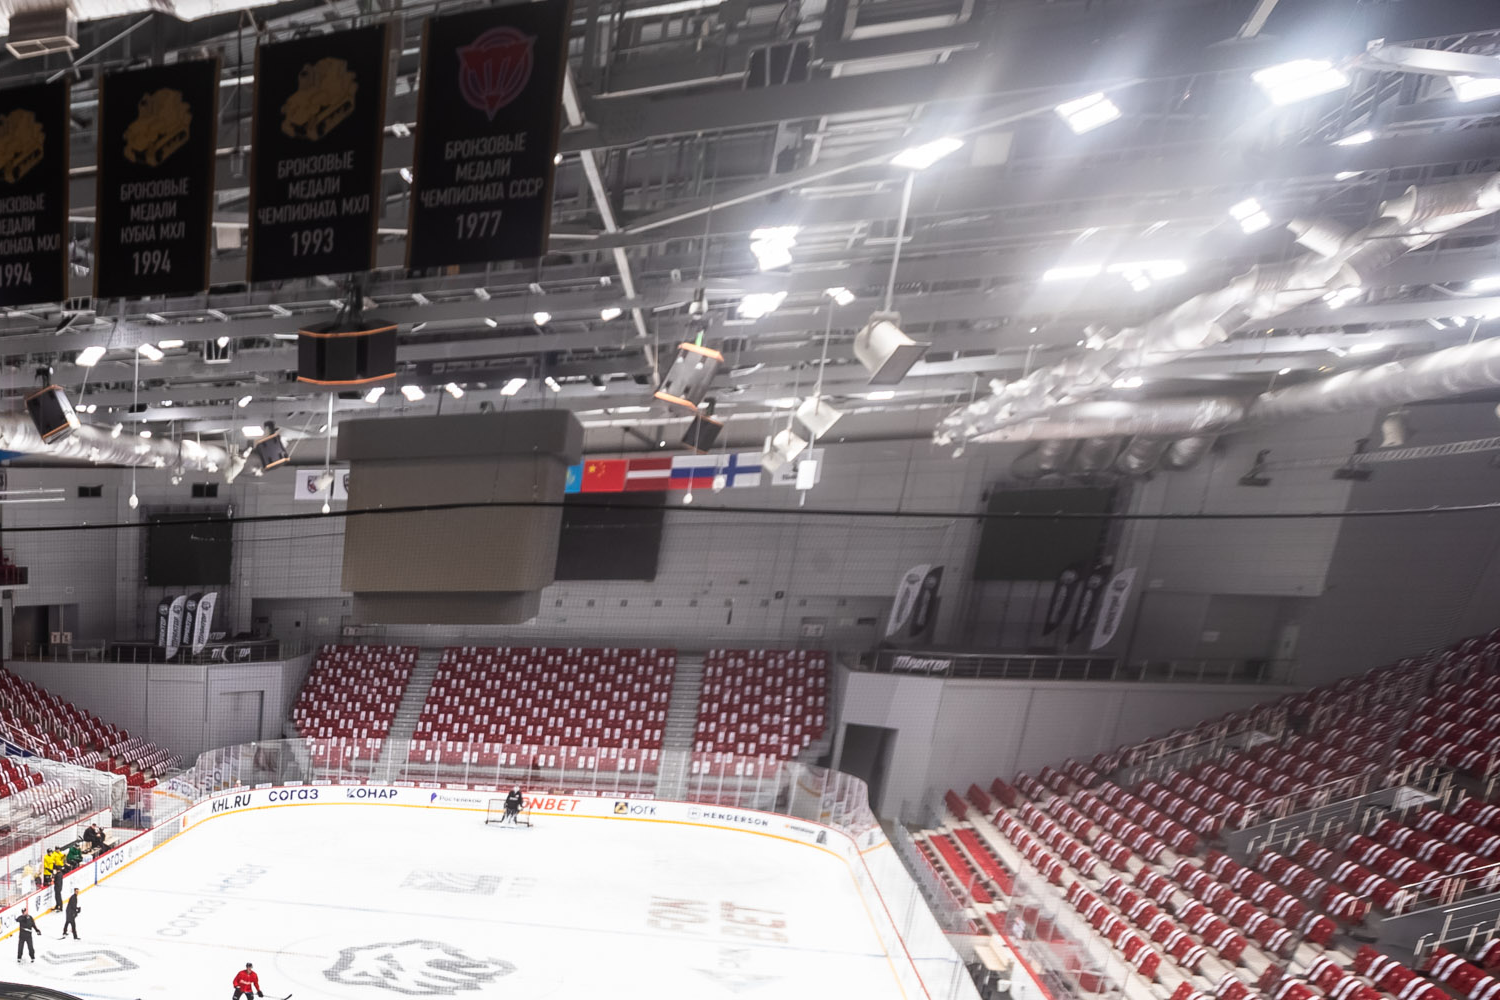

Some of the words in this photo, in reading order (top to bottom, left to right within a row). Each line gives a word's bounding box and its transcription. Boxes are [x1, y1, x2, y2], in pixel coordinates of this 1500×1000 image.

[444, 132, 527, 160] БРОНЗОВЫЕ
[277, 150, 355, 179] БРОНЗОВЫЕ
[455, 158, 511, 181] МЕДАЛИ
[120, 177, 189, 202] БРОНЗОВЫЕ
[288, 176, 340, 200] МЕДАЛИ
[420, 182, 505, 209] ЧЕМПИОНАТА
[508, 177, 544, 201] СССР
[130, 202, 177, 222] МЕДАЛИ
[258, 199, 337, 225] ЧЕМПИОНАТА
[341, 194, 370, 216] МХЛ
[121, 225, 157, 245] КУБКА
[160, 221, 185, 240] МХЛ
[455, 210, 503, 239] 1977
[37, 233, 61, 252] МХЛ
[290, 227, 334, 256] 1993
[132, 249, 171, 276] 1994
[212, 794, 251, 813] KHL.RU
[522, 797, 580, 812] ONBET
[630, 805, 657, 816] ЮГК
[703, 812, 769, 826] HENDERSON
